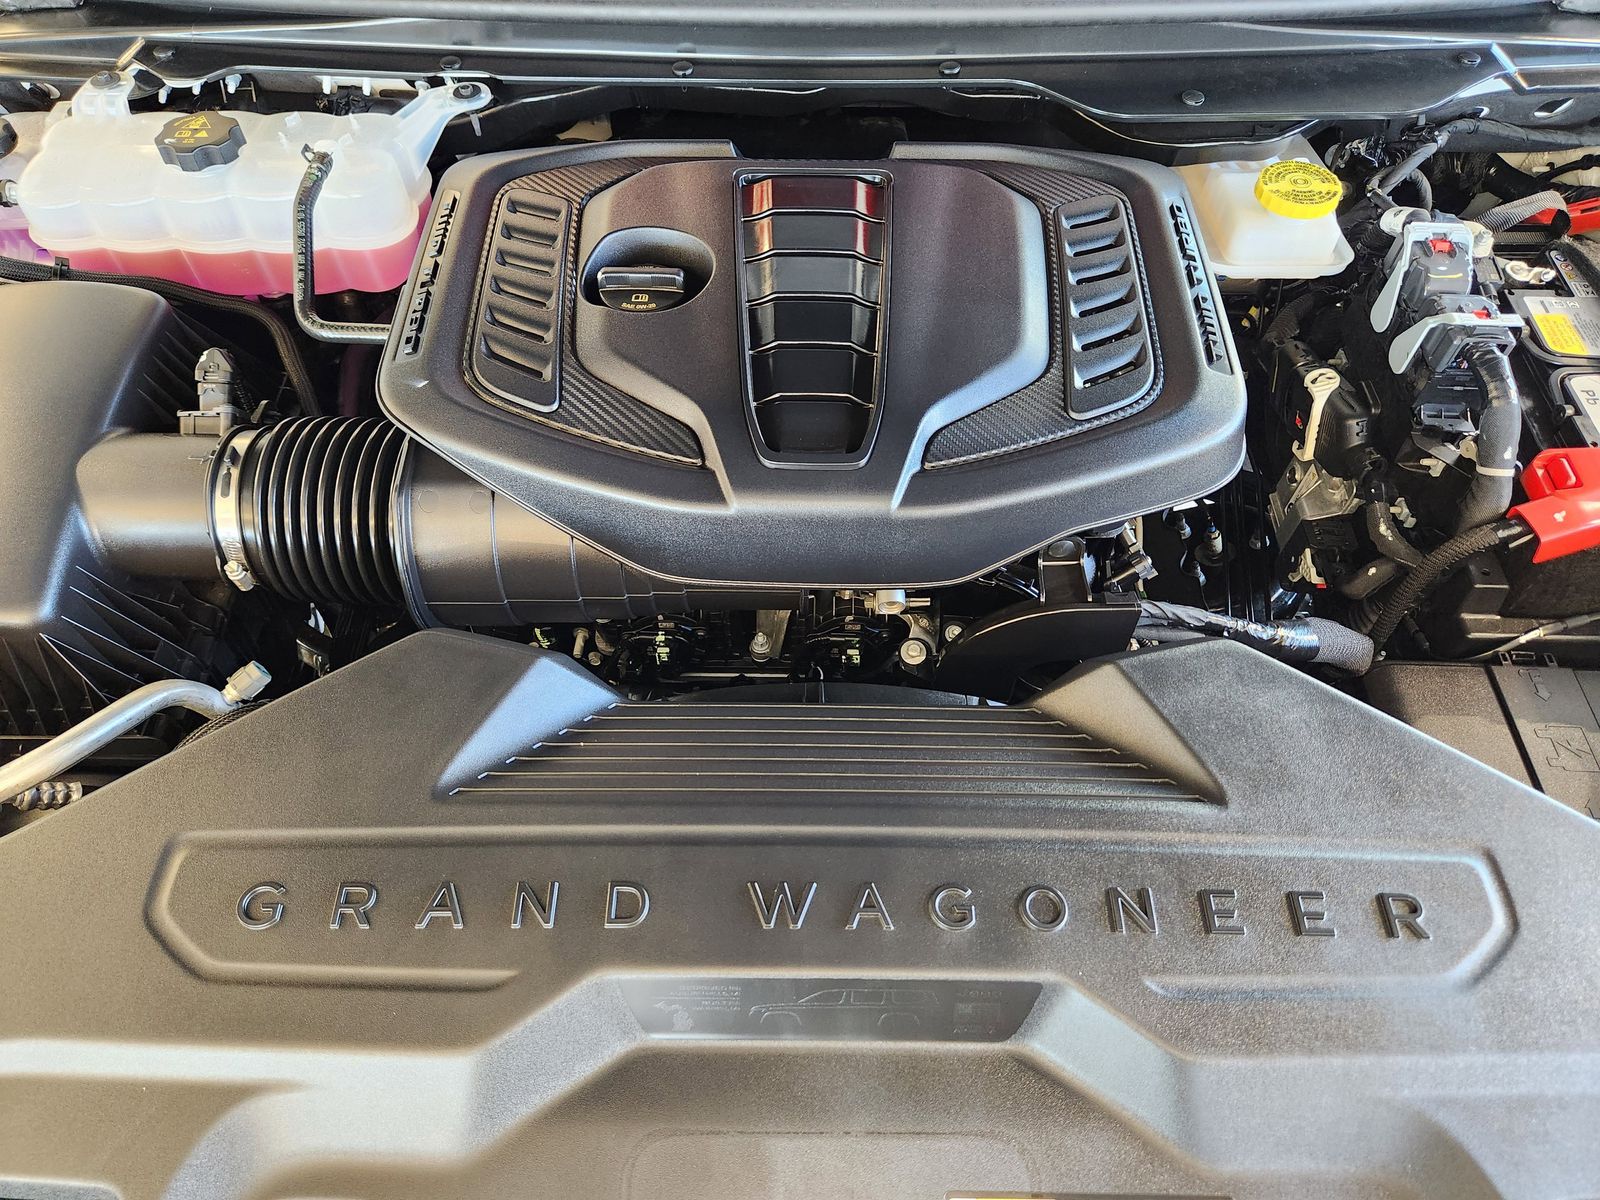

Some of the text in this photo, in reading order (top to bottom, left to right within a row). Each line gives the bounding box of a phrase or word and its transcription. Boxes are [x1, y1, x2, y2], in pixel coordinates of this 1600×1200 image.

[404, 195, 458, 355] TWIN TURBO
[1169, 202, 1224, 367] TWIN TURBO
[236, 880, 1431, 940] GRAND WAGONEER
